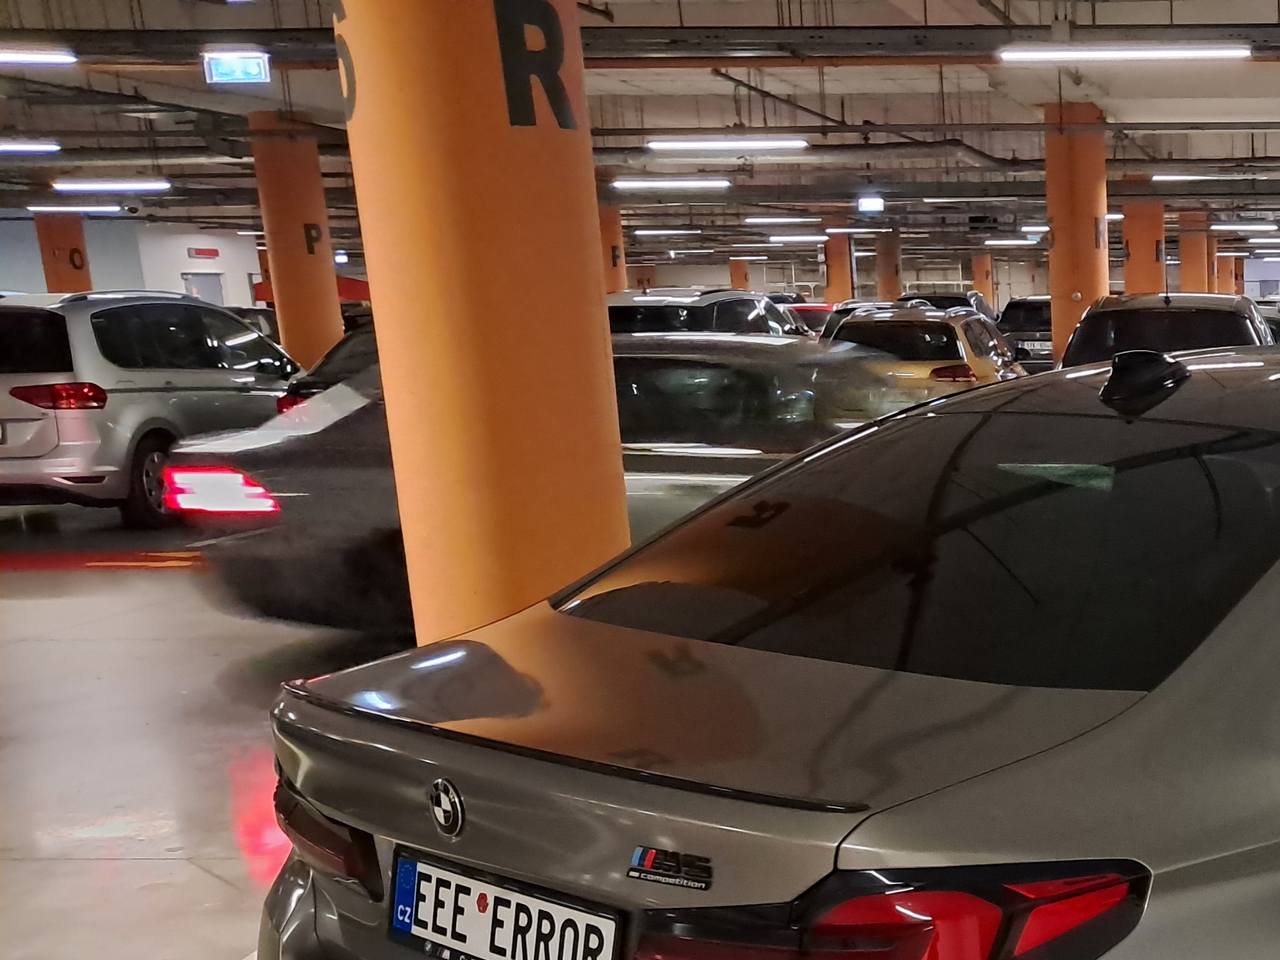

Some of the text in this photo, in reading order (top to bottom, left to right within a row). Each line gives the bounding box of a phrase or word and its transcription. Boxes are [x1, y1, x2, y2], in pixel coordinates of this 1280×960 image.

[494, 0, 577, 130] R
[304, 223, 322, 254] P
[640, 873, 706, 889] competition
[397, 904, 412, 924] CZ
[413, 871, 472, 944] EEE
